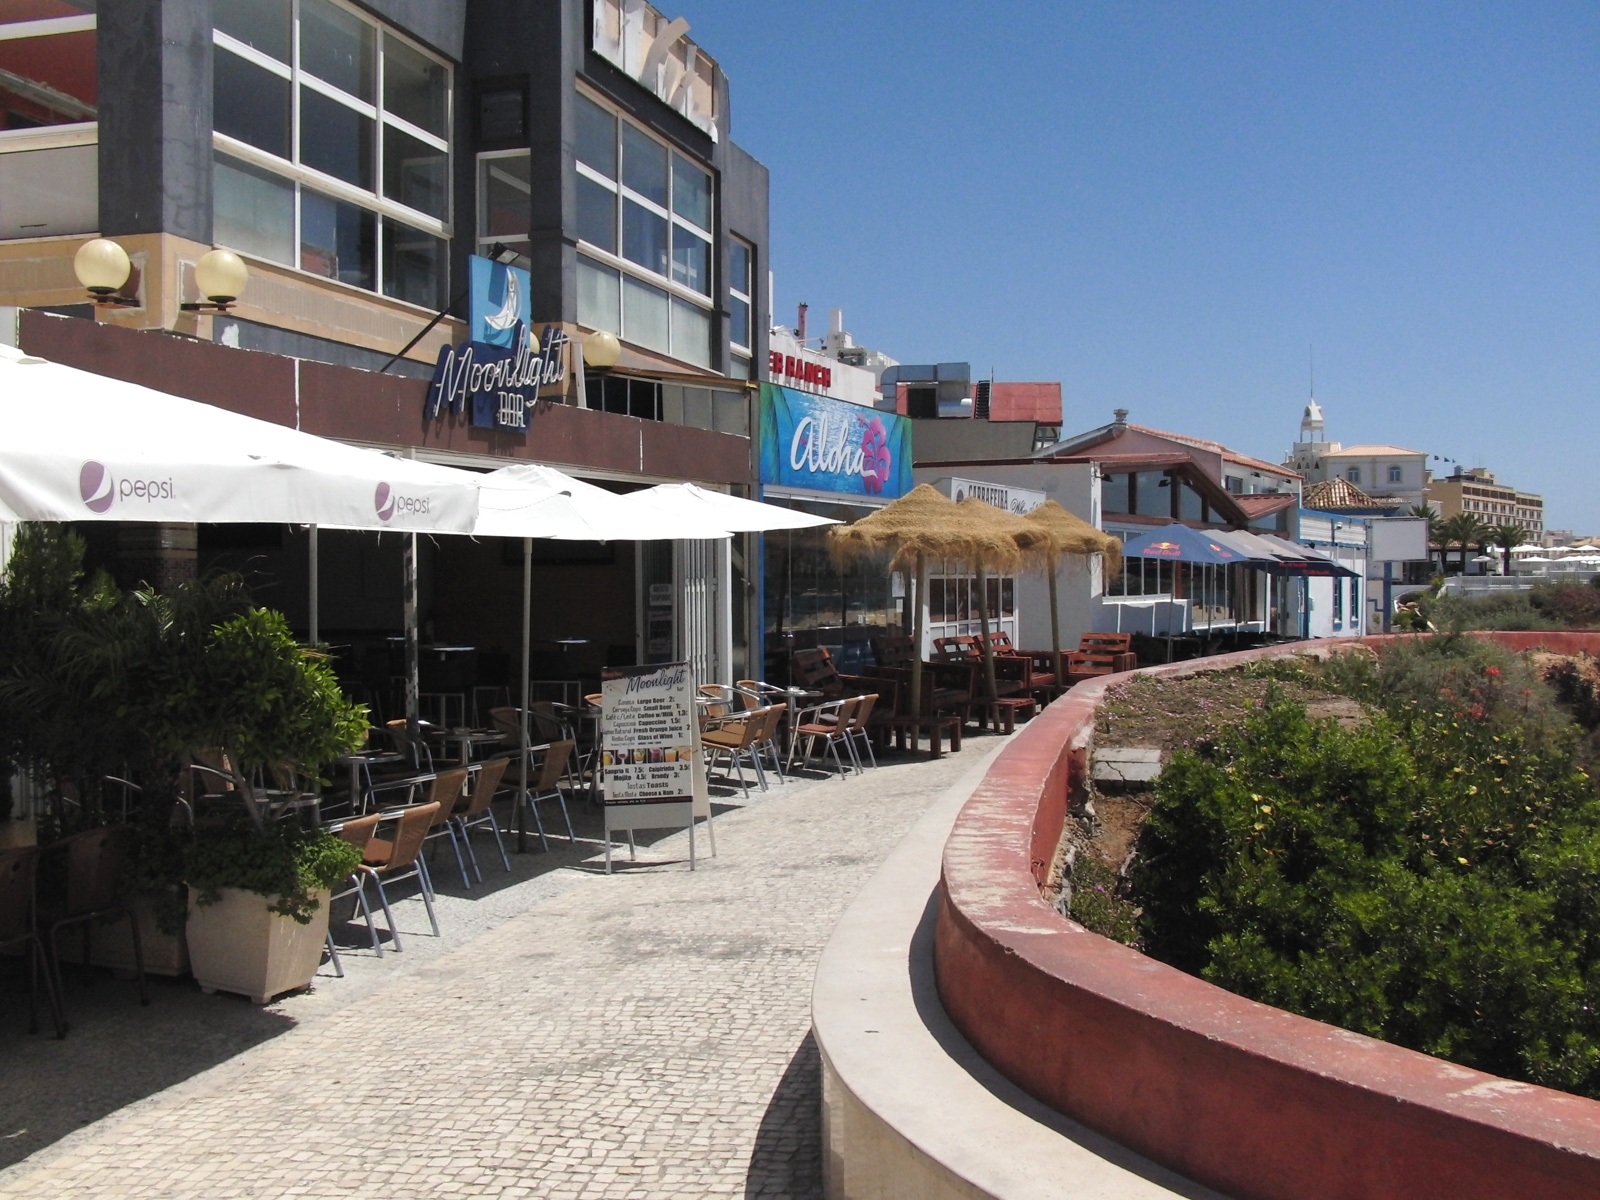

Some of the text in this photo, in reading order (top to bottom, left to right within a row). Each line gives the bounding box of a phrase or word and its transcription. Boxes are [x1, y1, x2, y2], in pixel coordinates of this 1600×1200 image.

[434, 324, 571, 417] Moonlight
[785, 355, 831, 388] RANCH
[790, 411, 878, 479] Aloha
[120, 477, 174, 503] pepsi
[397, 496, 430, 516] pepsi
[626, 668, 687, 695] Moonlight
[647, 781, 669, 789] Toasts
